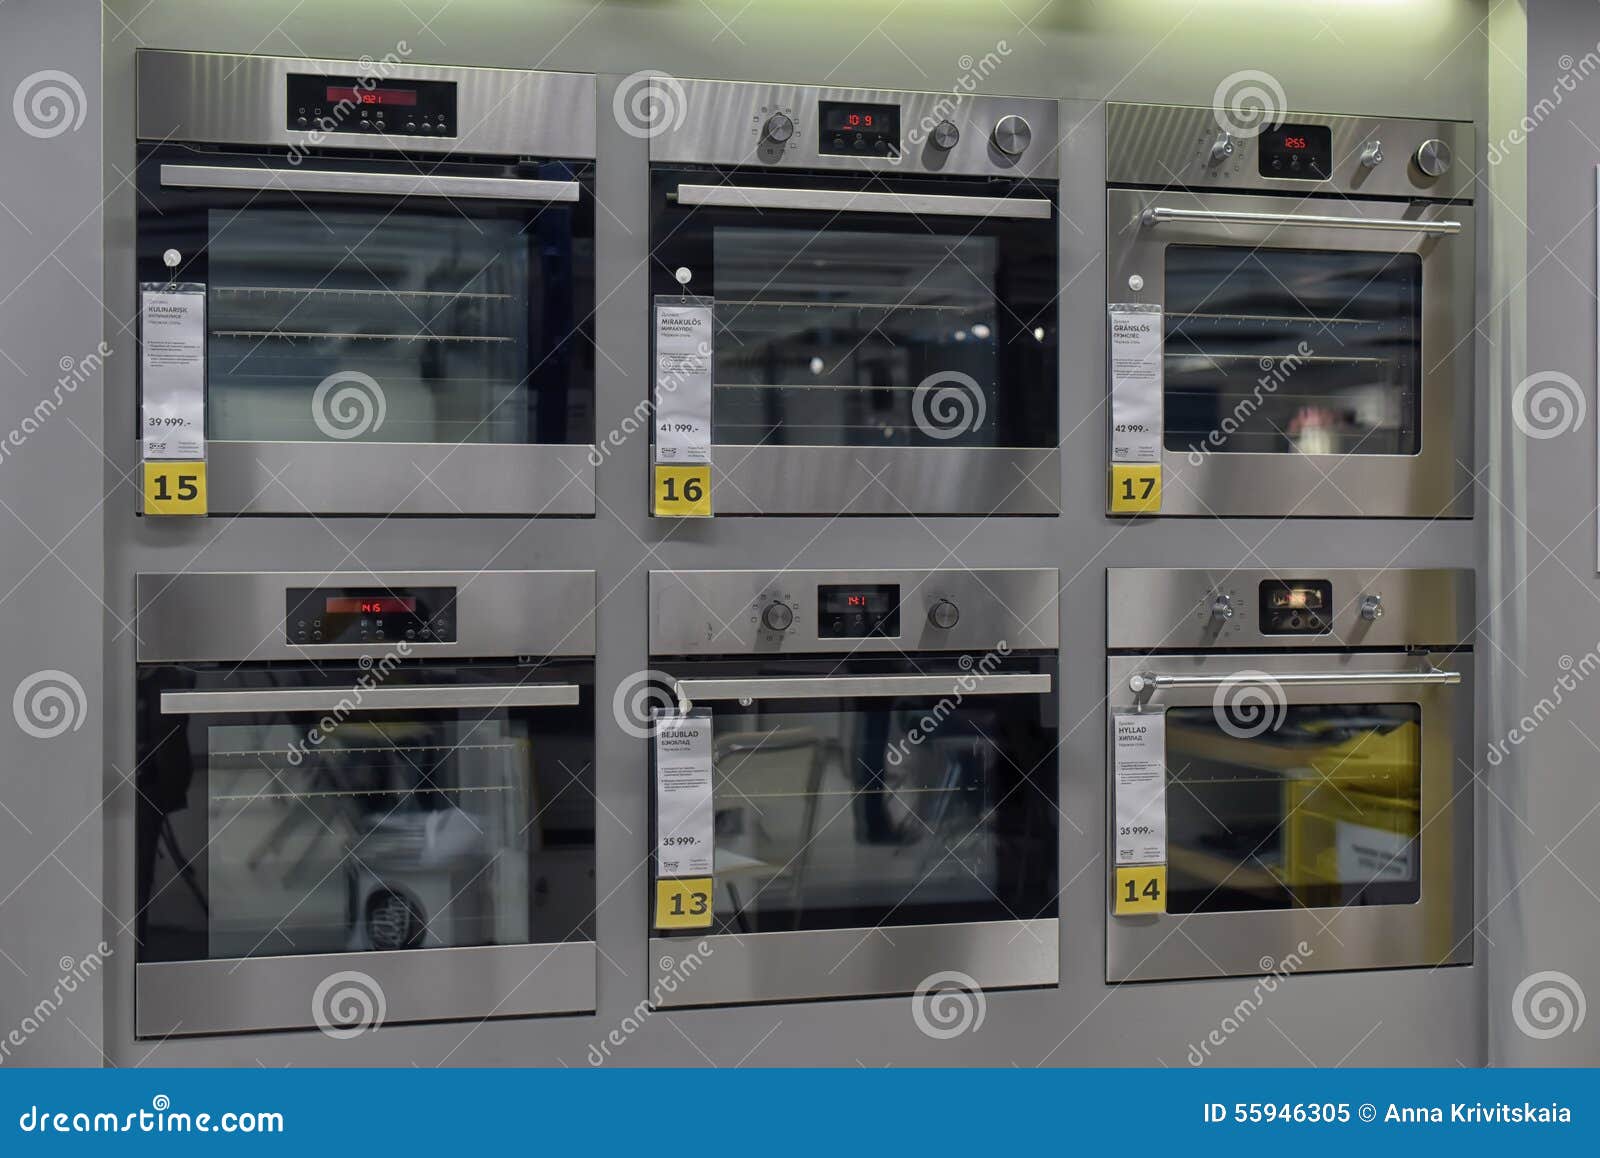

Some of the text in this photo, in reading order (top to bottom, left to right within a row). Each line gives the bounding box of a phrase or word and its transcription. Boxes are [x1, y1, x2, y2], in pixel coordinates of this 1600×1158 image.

[661, 318, 702, 326] MIRAKULÖS
[148, 418, 191, 427] 39 999.-
[660, 424, 699, 432] 41 999.-
[1115, 425, 1126, 433] 42
[154, 475, 198, 501] 15
[663, 477, 703, 502] 16
[1122, 478, 1155, 500] 17
[1118, 726, 1147, 734] HYLLAD
[1120, 826, 1131, 835] 35
[663, 837, 675, 846] 35
[1124, 879, 1160, 903] 14
[670, 892, 708, 916] 13
